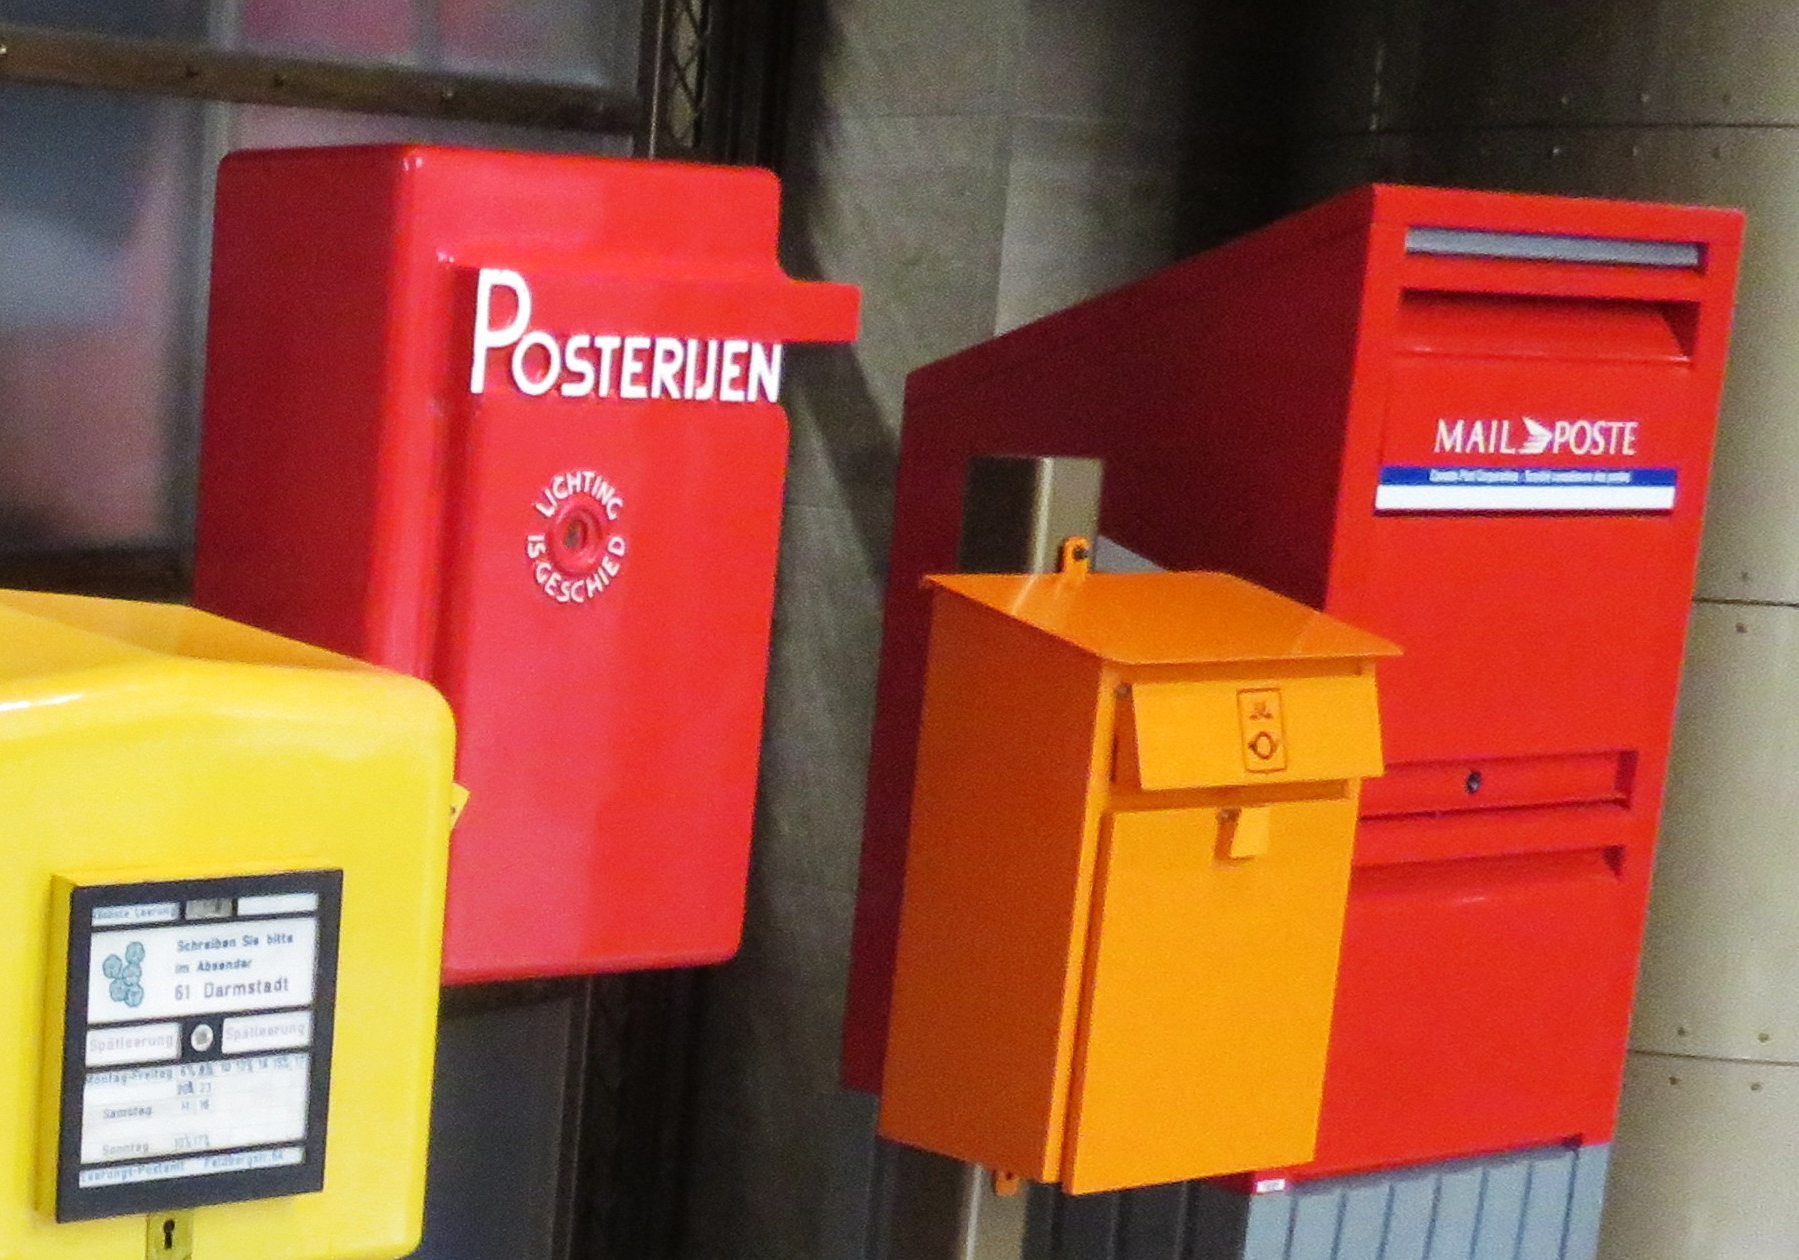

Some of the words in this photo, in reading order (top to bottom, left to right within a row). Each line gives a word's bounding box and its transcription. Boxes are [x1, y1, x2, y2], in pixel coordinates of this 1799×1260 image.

[470, 268, 783, 403] POSTERIJEN
[1434, 418, 1516, 454] MAIL
[1553, 420, 1639, 455] POSTE
[535, 470, 623, 520] LICHTING
[526, 534, 547, 559] IS
[535, 535, 627, 603] GESCHIED
[176, 938, 237, 953] Schreiben
[242, 935, 259, 947] Sie
[266, 932, 294, 945] bitte
[196, 958, 253, 972] Absender
[174, 984, 191, 1001] 61
[204, 977, 289, 999] Darmstadt
